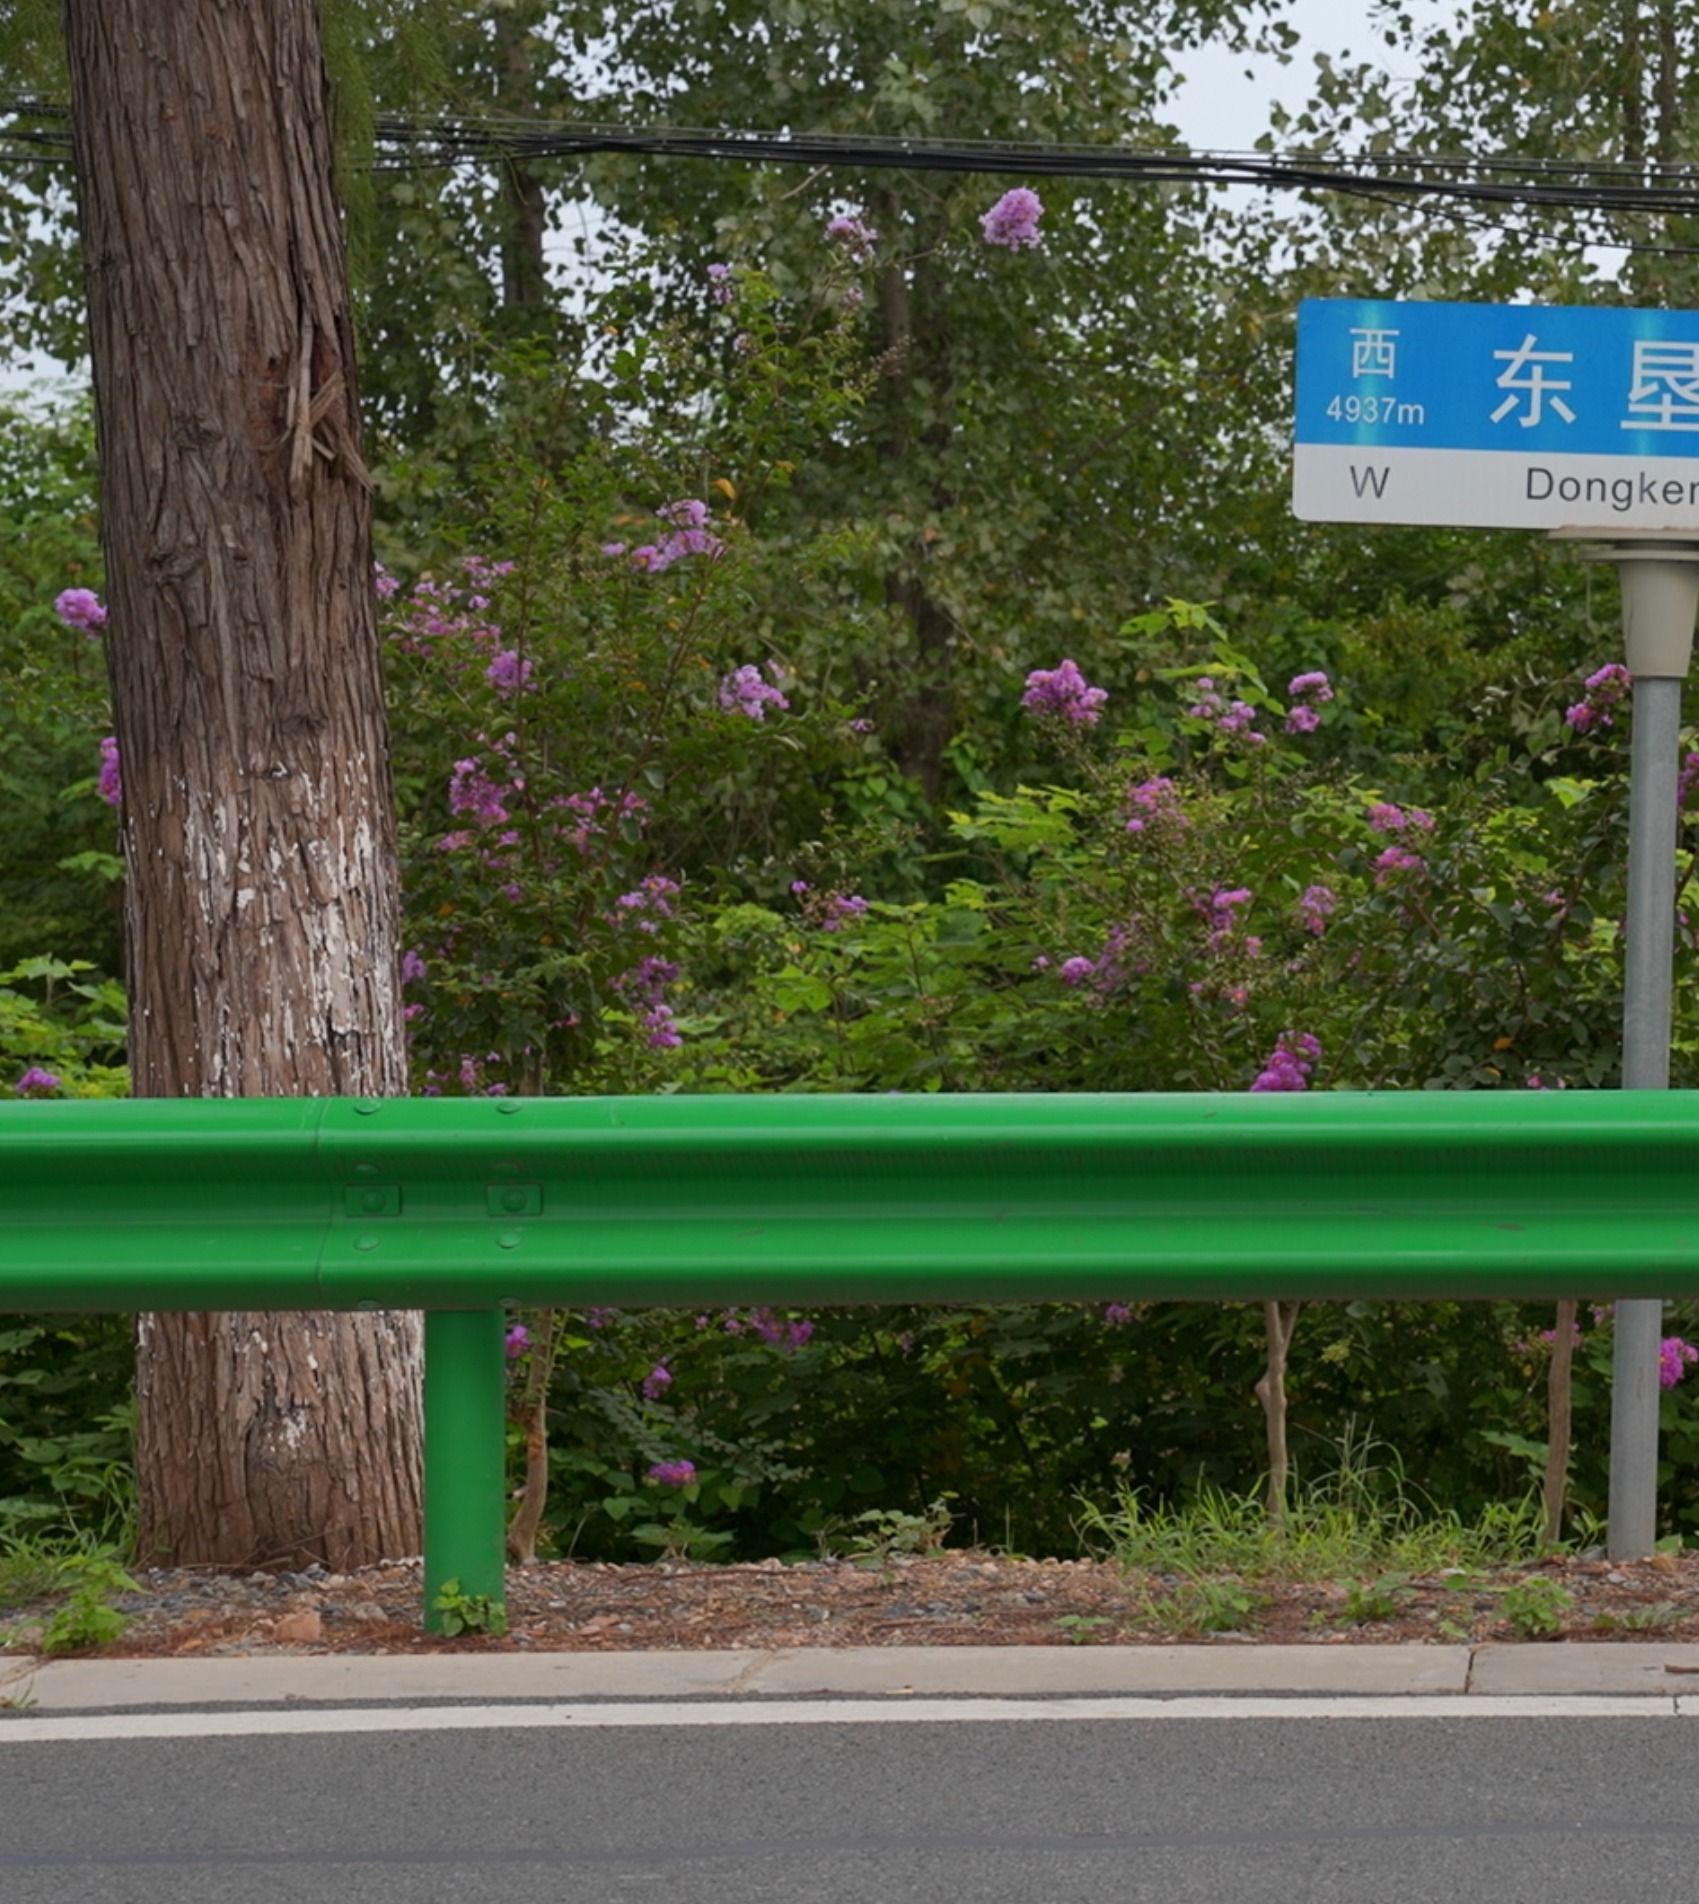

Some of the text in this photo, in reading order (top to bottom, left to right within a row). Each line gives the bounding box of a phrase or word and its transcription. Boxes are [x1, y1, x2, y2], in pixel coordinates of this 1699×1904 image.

[1350, 328, 1398, 378] 西
[1326, 396, 1424, 424] 4937m
[1350, 465, 1391, 499] W
